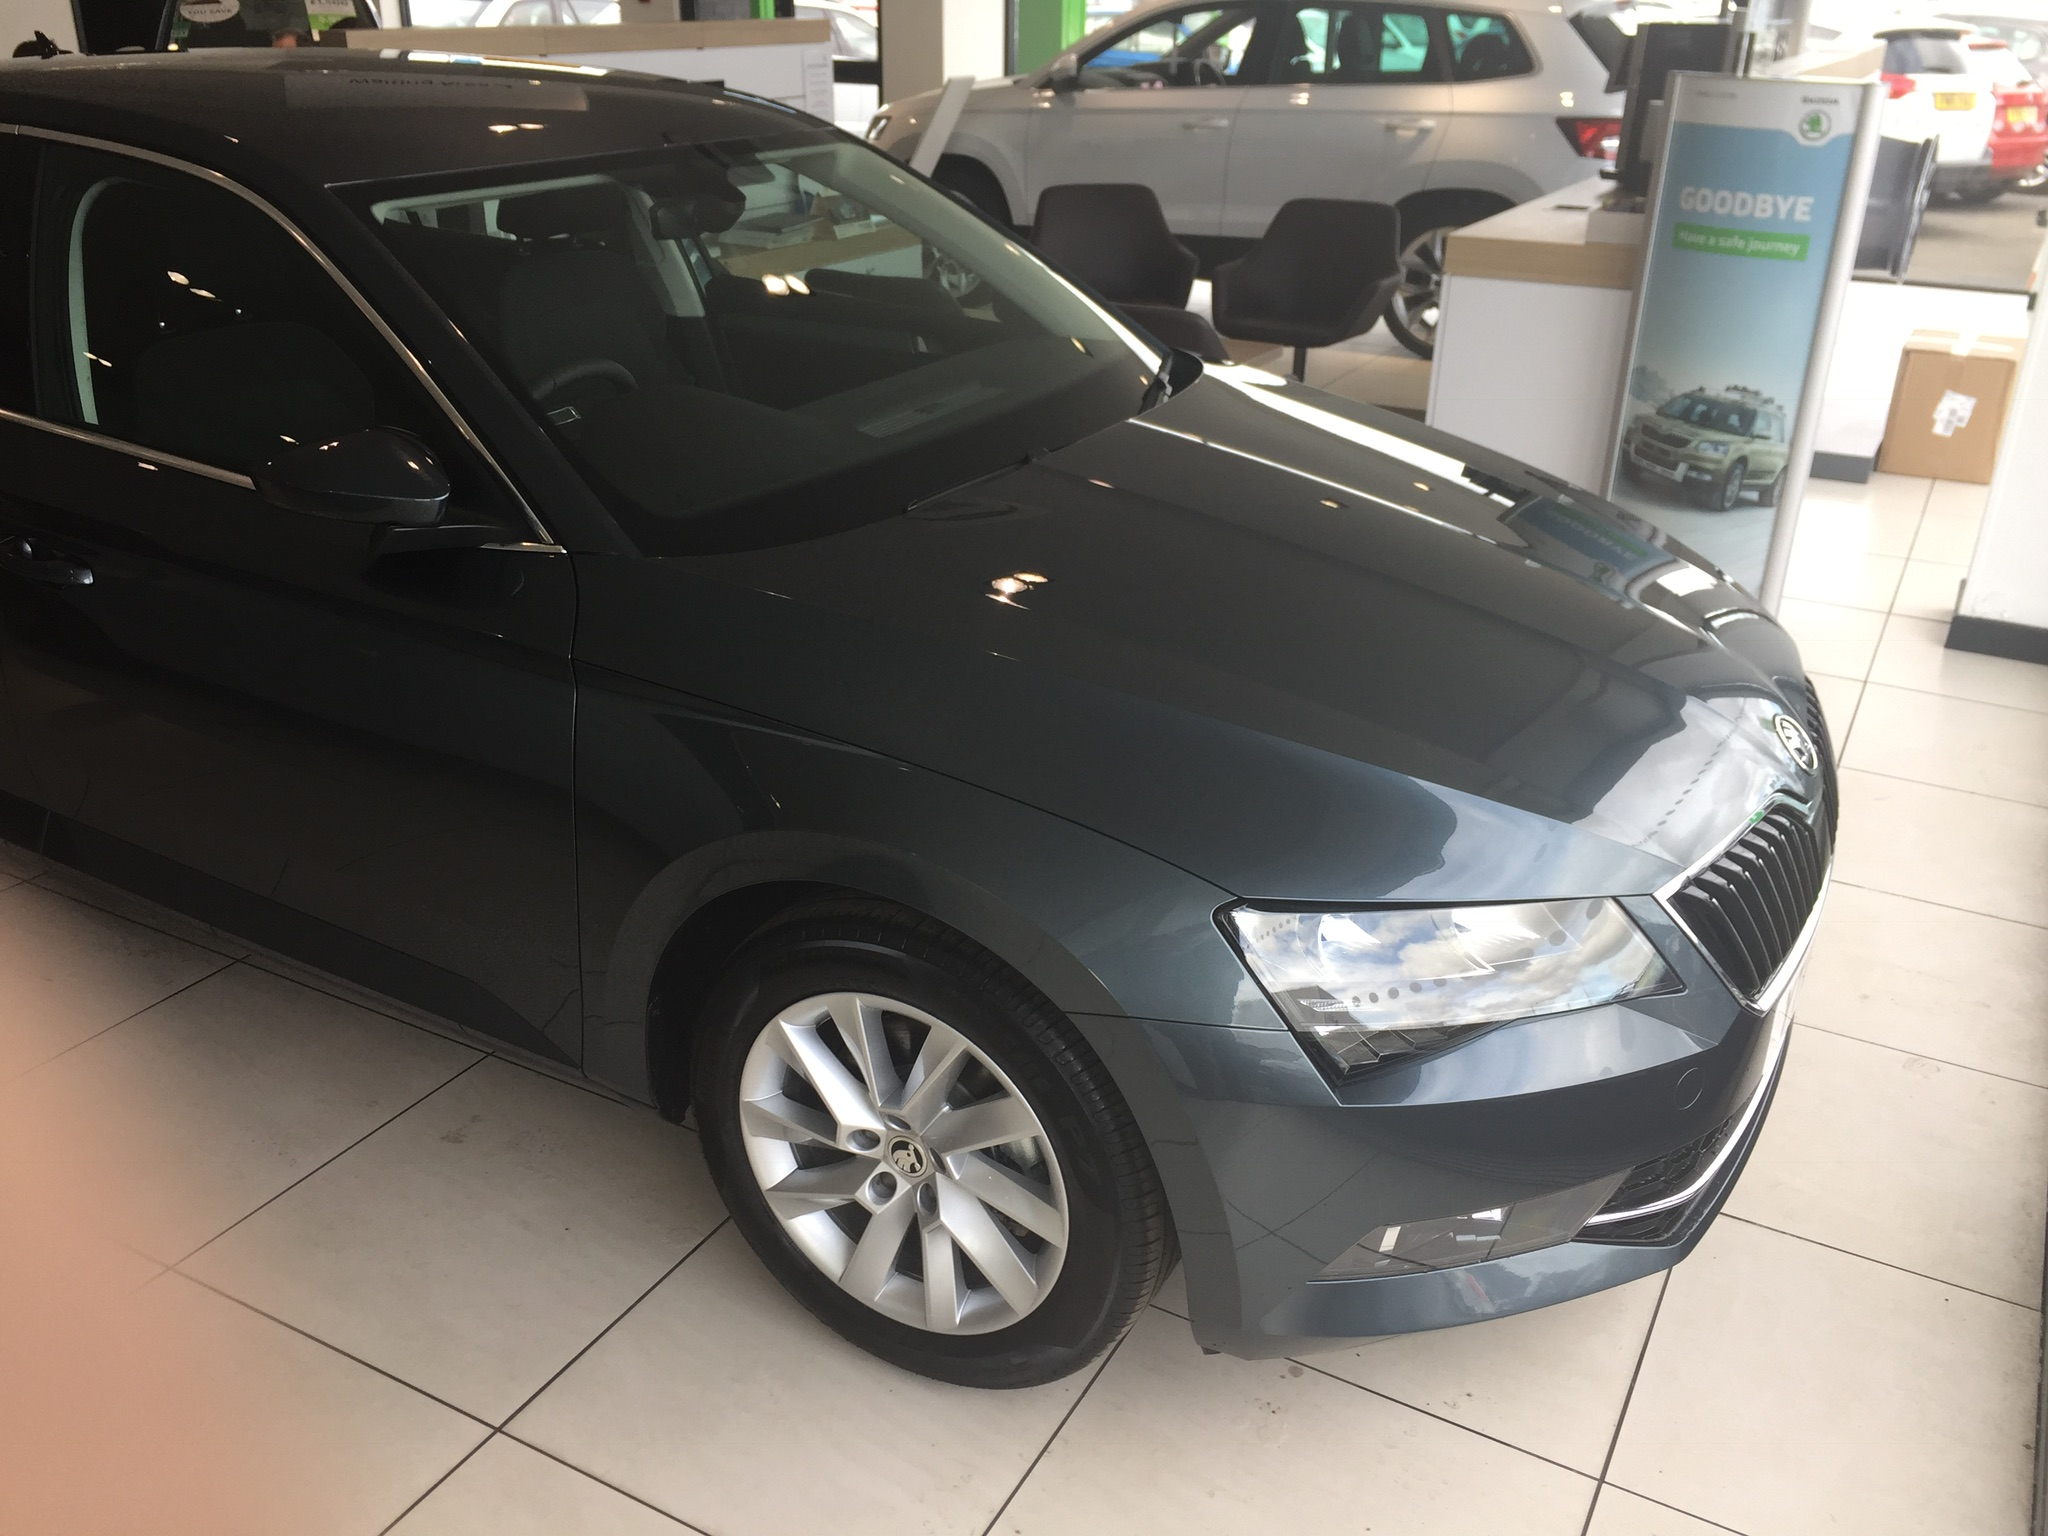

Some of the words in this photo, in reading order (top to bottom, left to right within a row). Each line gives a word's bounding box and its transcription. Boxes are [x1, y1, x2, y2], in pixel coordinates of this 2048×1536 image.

[1680, 186, 1814, 222] GOODBYE
[1680, 230, 1706, 245] Have
[1708, 235, 1716, 246] a
[1718, 235, 1746, 249] safe
[1746, 237, 1801, 258] journey
